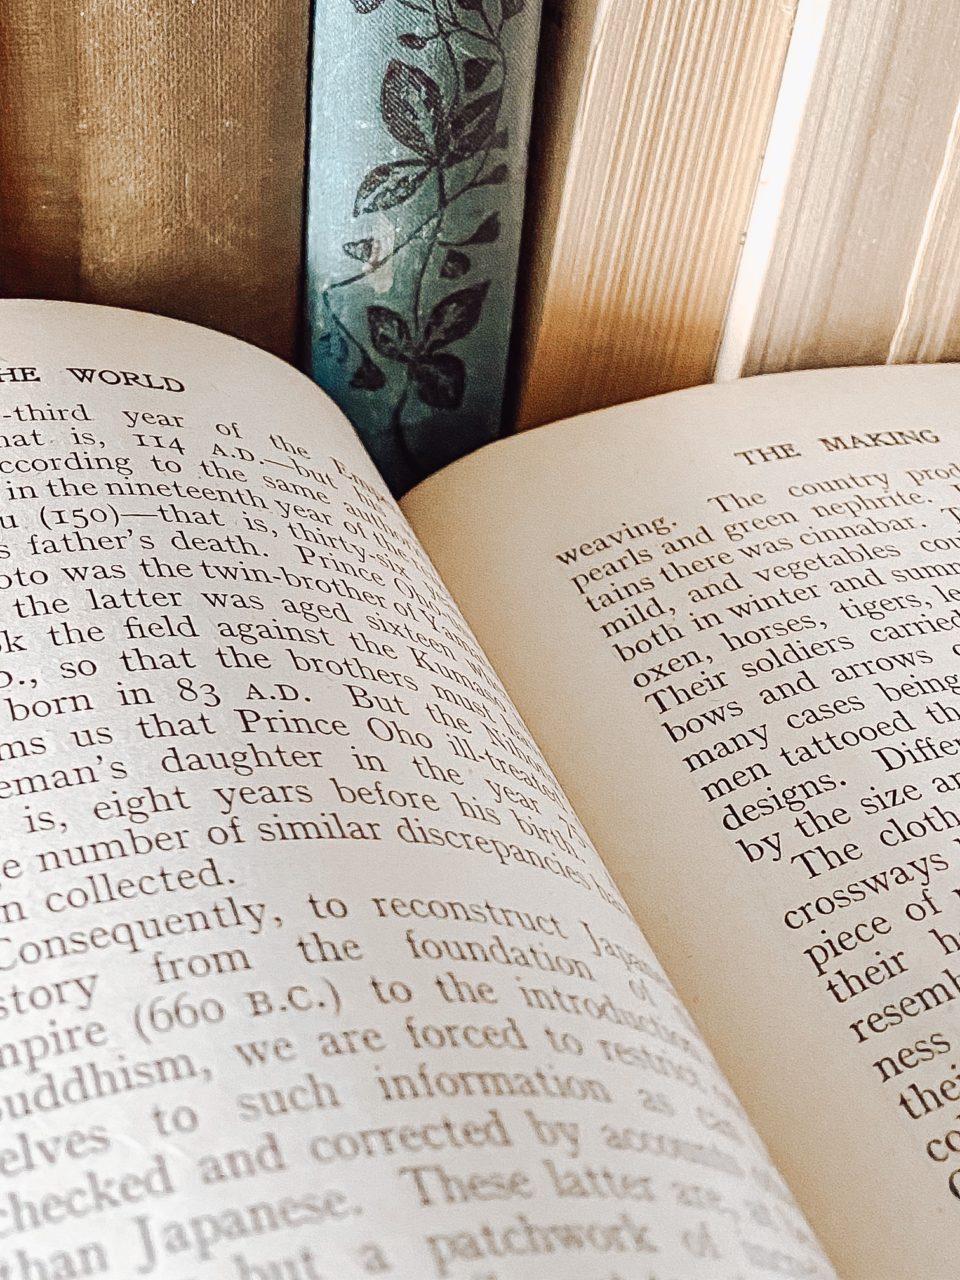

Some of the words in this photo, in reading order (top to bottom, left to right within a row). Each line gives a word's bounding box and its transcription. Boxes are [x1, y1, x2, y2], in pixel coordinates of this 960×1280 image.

[65, 368, 185, 393] WORLD
[70, 432, 105, 449] is,
[121, 411, 184, 428] year
[215, 422, 243, 439] of
[269, 434, 311, 460] the
[733, 443, 802, 466] THE
[818, 429, 940, 452] MAKING
[5, 485, 39, 501] in
[45, 477, 98, 498] the
[104, 477, 271, 509] nineteenth
[273, 499, 333, 526] year
[343, 521, 369, 540] of
[150, 455, 182, 473] to
[199, 460, 248, 483] the
[262, 476, 331, 505] same
[243, 517, 278, 538] is,
[555, 517, 677, 565] weaving.
[707, 493, 767, 513] The
[788, 473, 889, 497] country
[570, 548, 653, 595] pearls
[661, 525, 716, 555] and
[723, 511, 800, 542] green
[811, 491, 933, 518] nephrite.
[60, 564, 126, 582] was
[138, 556, 193, 578] the
[198, 559, 388, 610] twin-brother
[393, 602, 420, 622] of
[171, 530, 269, 557] death.
[293, 544, 386, 587] Prince
[585, 577, 655, 612] tains
[659, 552, 735, 583] there
[737, 538, 794, 558] was
[799, 517, 927, 545] cinnabar.
[12, 594, 70, 618] the
[85, 587, 183, 610] latter
[200, 592, 264, 610] was
[281, 599, 354, 624] aged
[599, 596, 676, 638] mild,
[687, 571, 744, 603] and
[752, 543, 901, 582] vegetables
[611, 623, 686, 662] both
[690, 613, 725, 632] in
[725, 586, 821, 619] winter
[829, 568, 887, 593] and
[633, 651, 713, 688] oxen,
[718, 615, 827, 652] horses,
[839, 594, 933, 621] tigers,
[644, 671, 729, 715] Their
[741, 636, 855, 678] soldiers
[660, 701, 743, 743] bows
[759, 670, 820, 705] and
[831, 650, 934, 683] arrows
[682, 723, 768, 773] many
[787, 695, 865, 729] cases
[700, 763, 772, 803] men
[779, 710, 917, 766] tattooed
[723, 774, 846, 830] designs.
[735, 832, 782, 863] by
[794, 808, 851, 838] the
[860, 784, 923, 815] size
[35, 828, 189, 873] number
[207, 815, 246, 845] of
[257, 812, 382, 842] similar
[790, 843, 863, 879] The
[45, 857, 235, 913] collected.
[308, 893, 348, 919] to
[371, 898, 568, 939] reconstruct
[784, 853, 949, 929] crossways
[803, 916, 892, 978] piece
[905, 888, 943, 921] of
[826, 951, 909, 1003] their
[872, 1033, 951, 1083] ness
